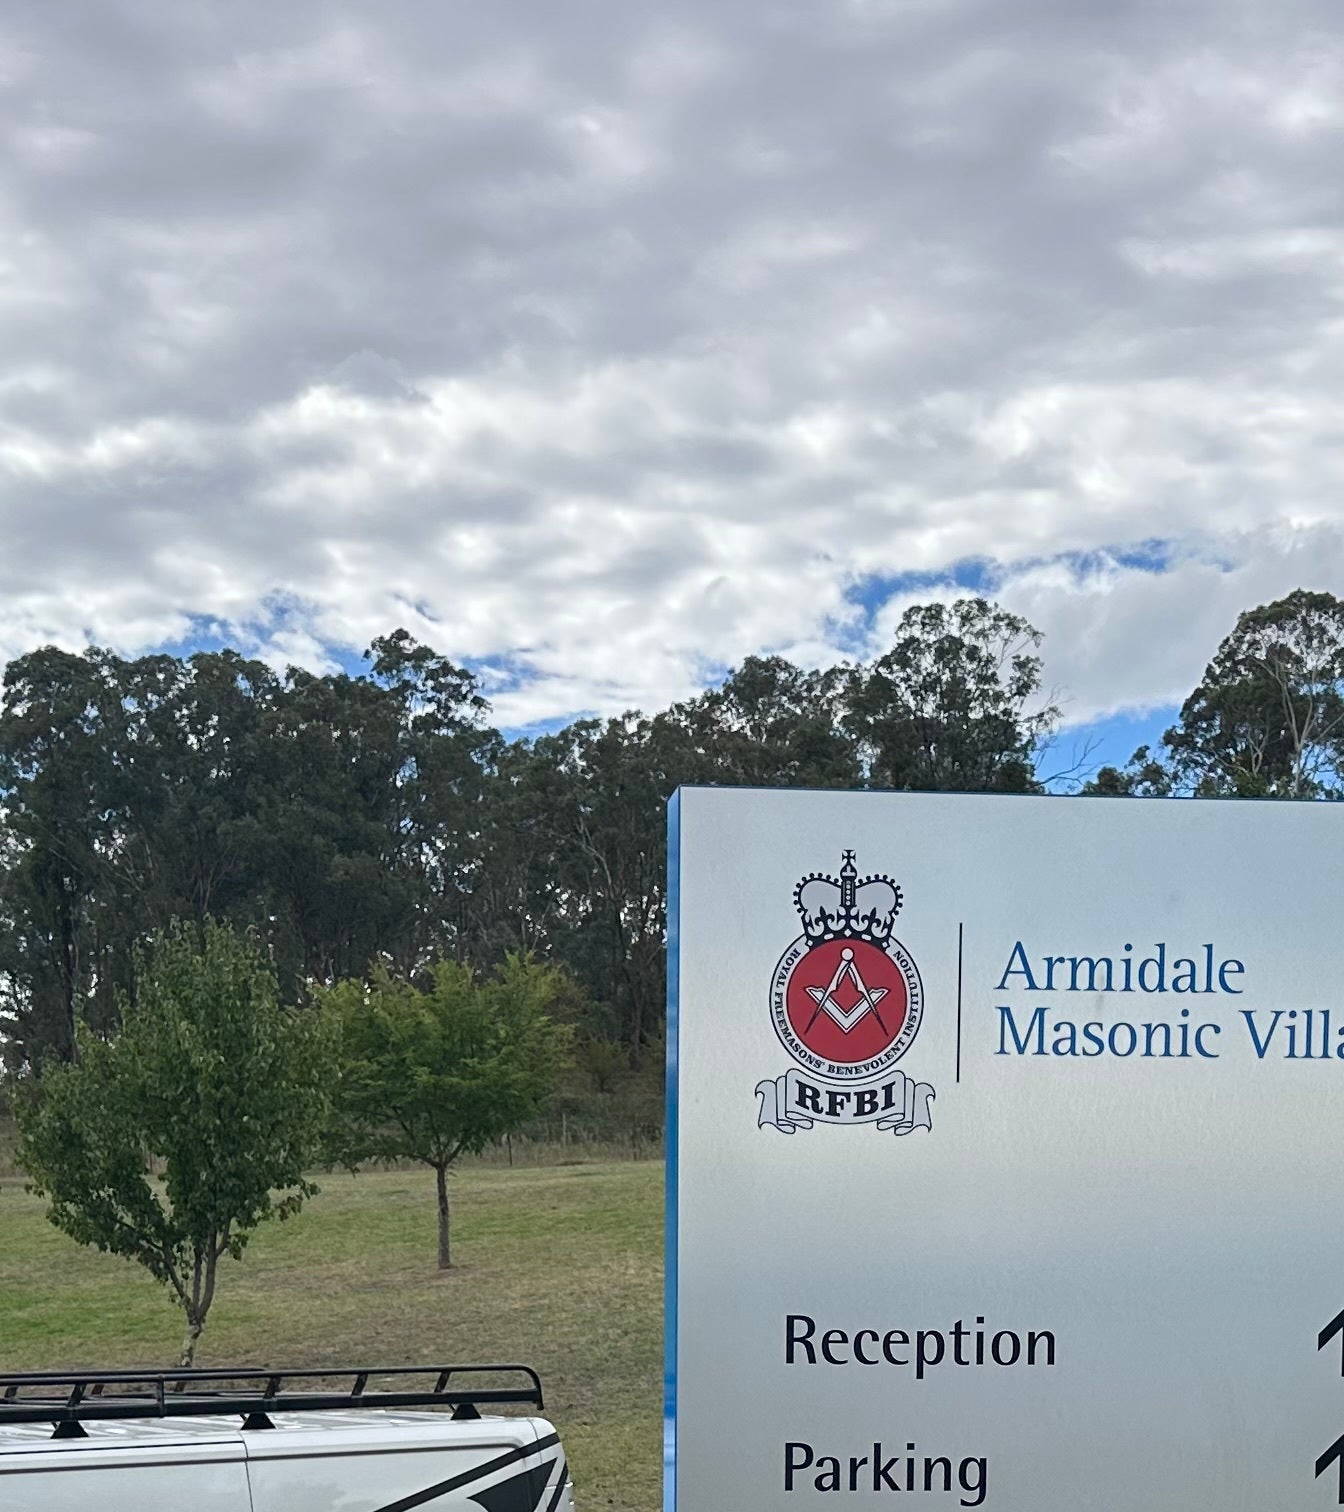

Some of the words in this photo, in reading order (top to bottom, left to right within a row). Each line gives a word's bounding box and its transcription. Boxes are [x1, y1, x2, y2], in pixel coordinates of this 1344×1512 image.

[993, 941, 1245, 993] Armidale
[775, 948, 802, 988] ROYAL
[826, 1036, 906, 1075] BENEVOLENT
[892, 950, 919, 1038] INSTITUTION
[994, 1006, 1221, 1058] Masonic
[794, 1079, 897, 1118] RFBI
[783, 1314, 1057, 1379] Reception
[783, 1442, 989, 1507] Parking
